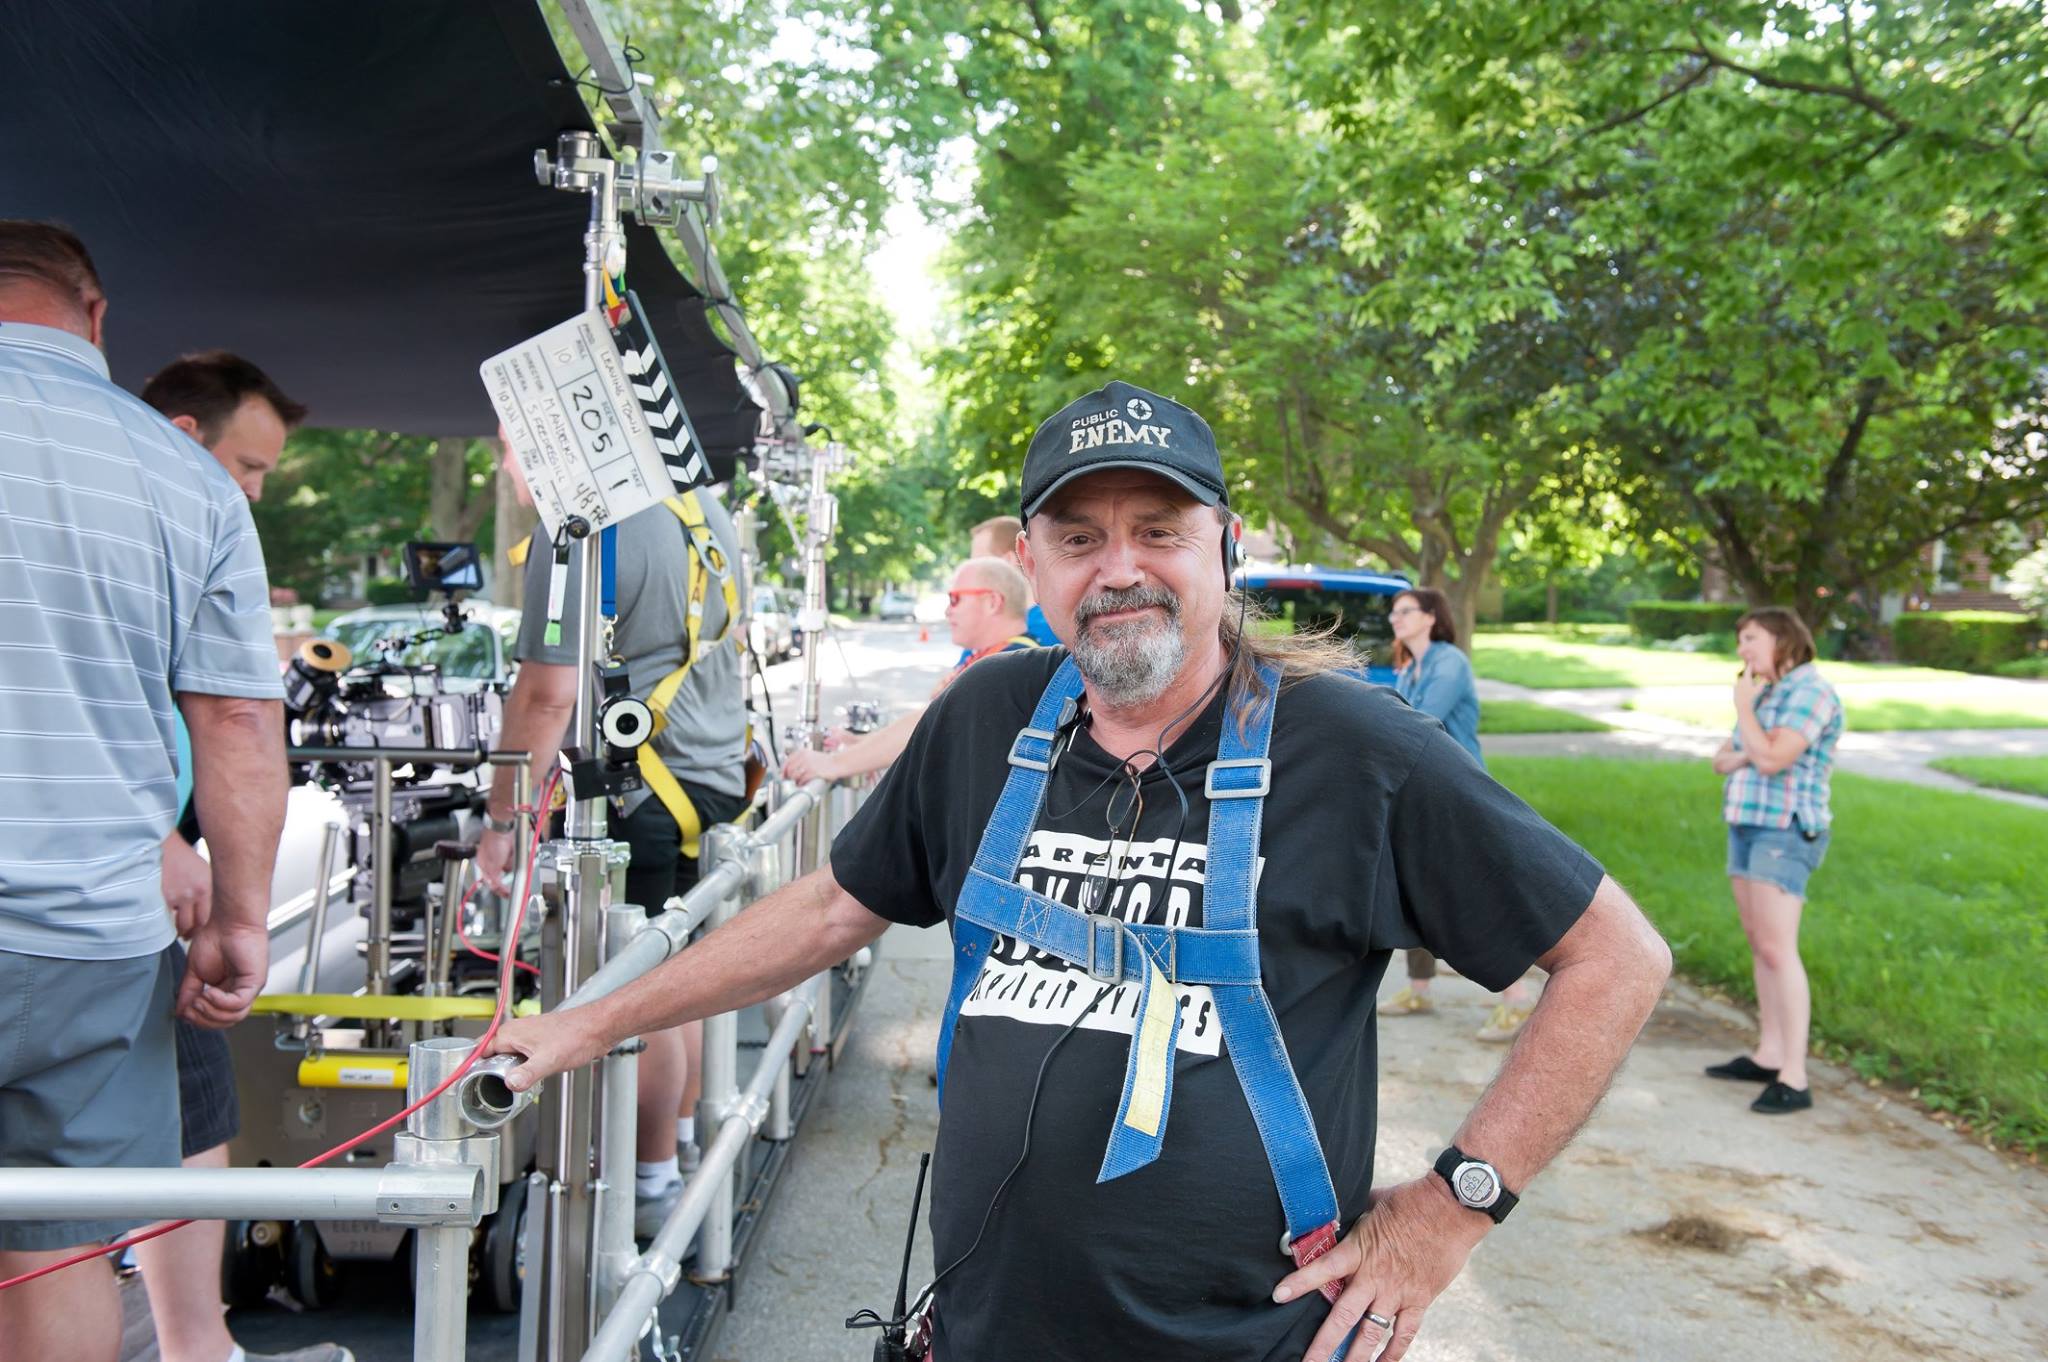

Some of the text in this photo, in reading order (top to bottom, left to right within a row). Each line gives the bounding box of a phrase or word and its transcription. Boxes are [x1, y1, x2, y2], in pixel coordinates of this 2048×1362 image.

[554, 346, 571, 364] 10
[494, 366, 507, 389] DATE
[510, 358, 528, 392] CAMERA
[523, 352, 545, 391] DIRECTOR
[600, 352, 641, 434] LEAVING TOWN
[572, 385, 613, 453] 205
[601, 401, 618, 427] SCENE
[1072, 408, 1119, 429] PUBLIC
[543, 397, 578, 465] M ANDREWS
[1069, 419, 1172, 455] ENEMY
[608, 478, 629, 491] 1
[629, 468, 643, 489] TAKE
[573, 482, 594, 510] 48
